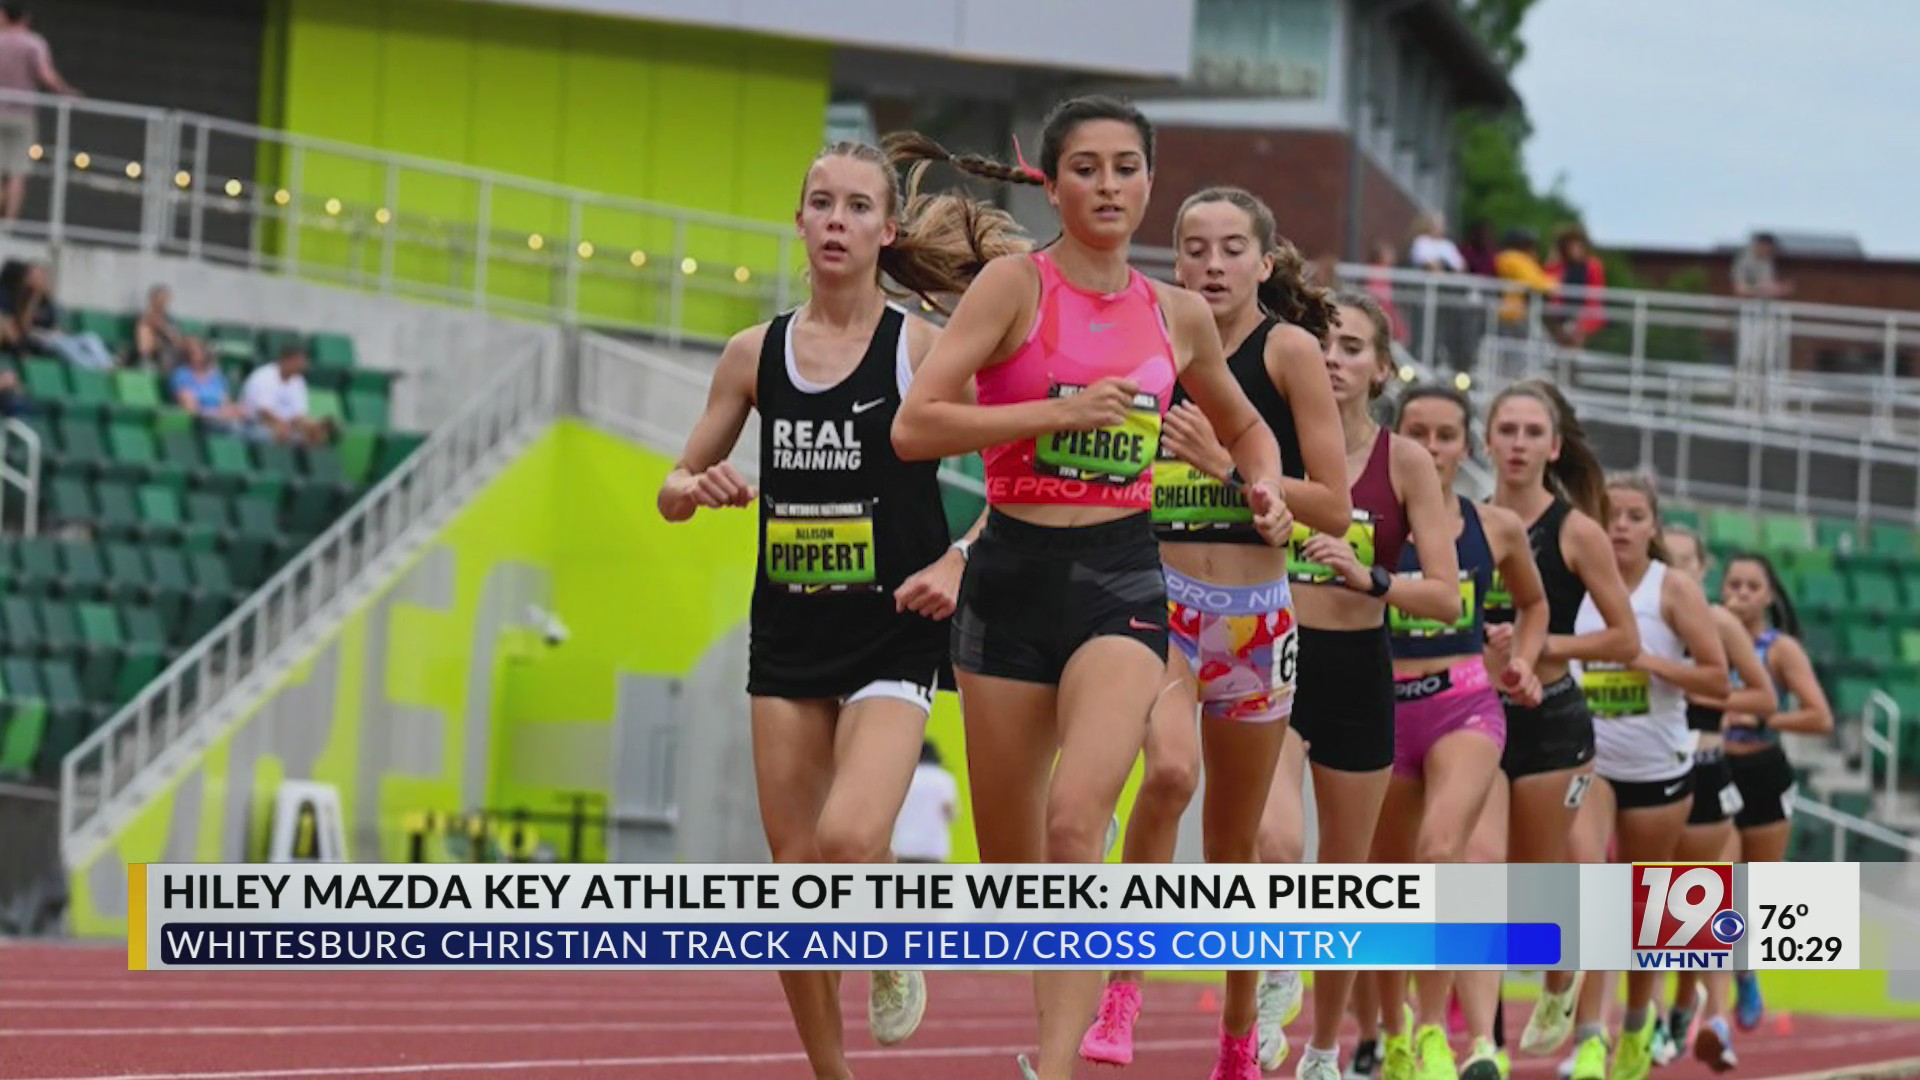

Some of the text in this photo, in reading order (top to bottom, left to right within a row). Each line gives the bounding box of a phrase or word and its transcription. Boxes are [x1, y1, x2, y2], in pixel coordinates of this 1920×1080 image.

[773, 419, 862, 449] REAL
[1051, 427, 1144, 465] PIERCE
[773, 450, 862, 470] TRAINING
[1013, 477, 1089, 499] PRO
[771, 542, 868, 572] PIPPERT
